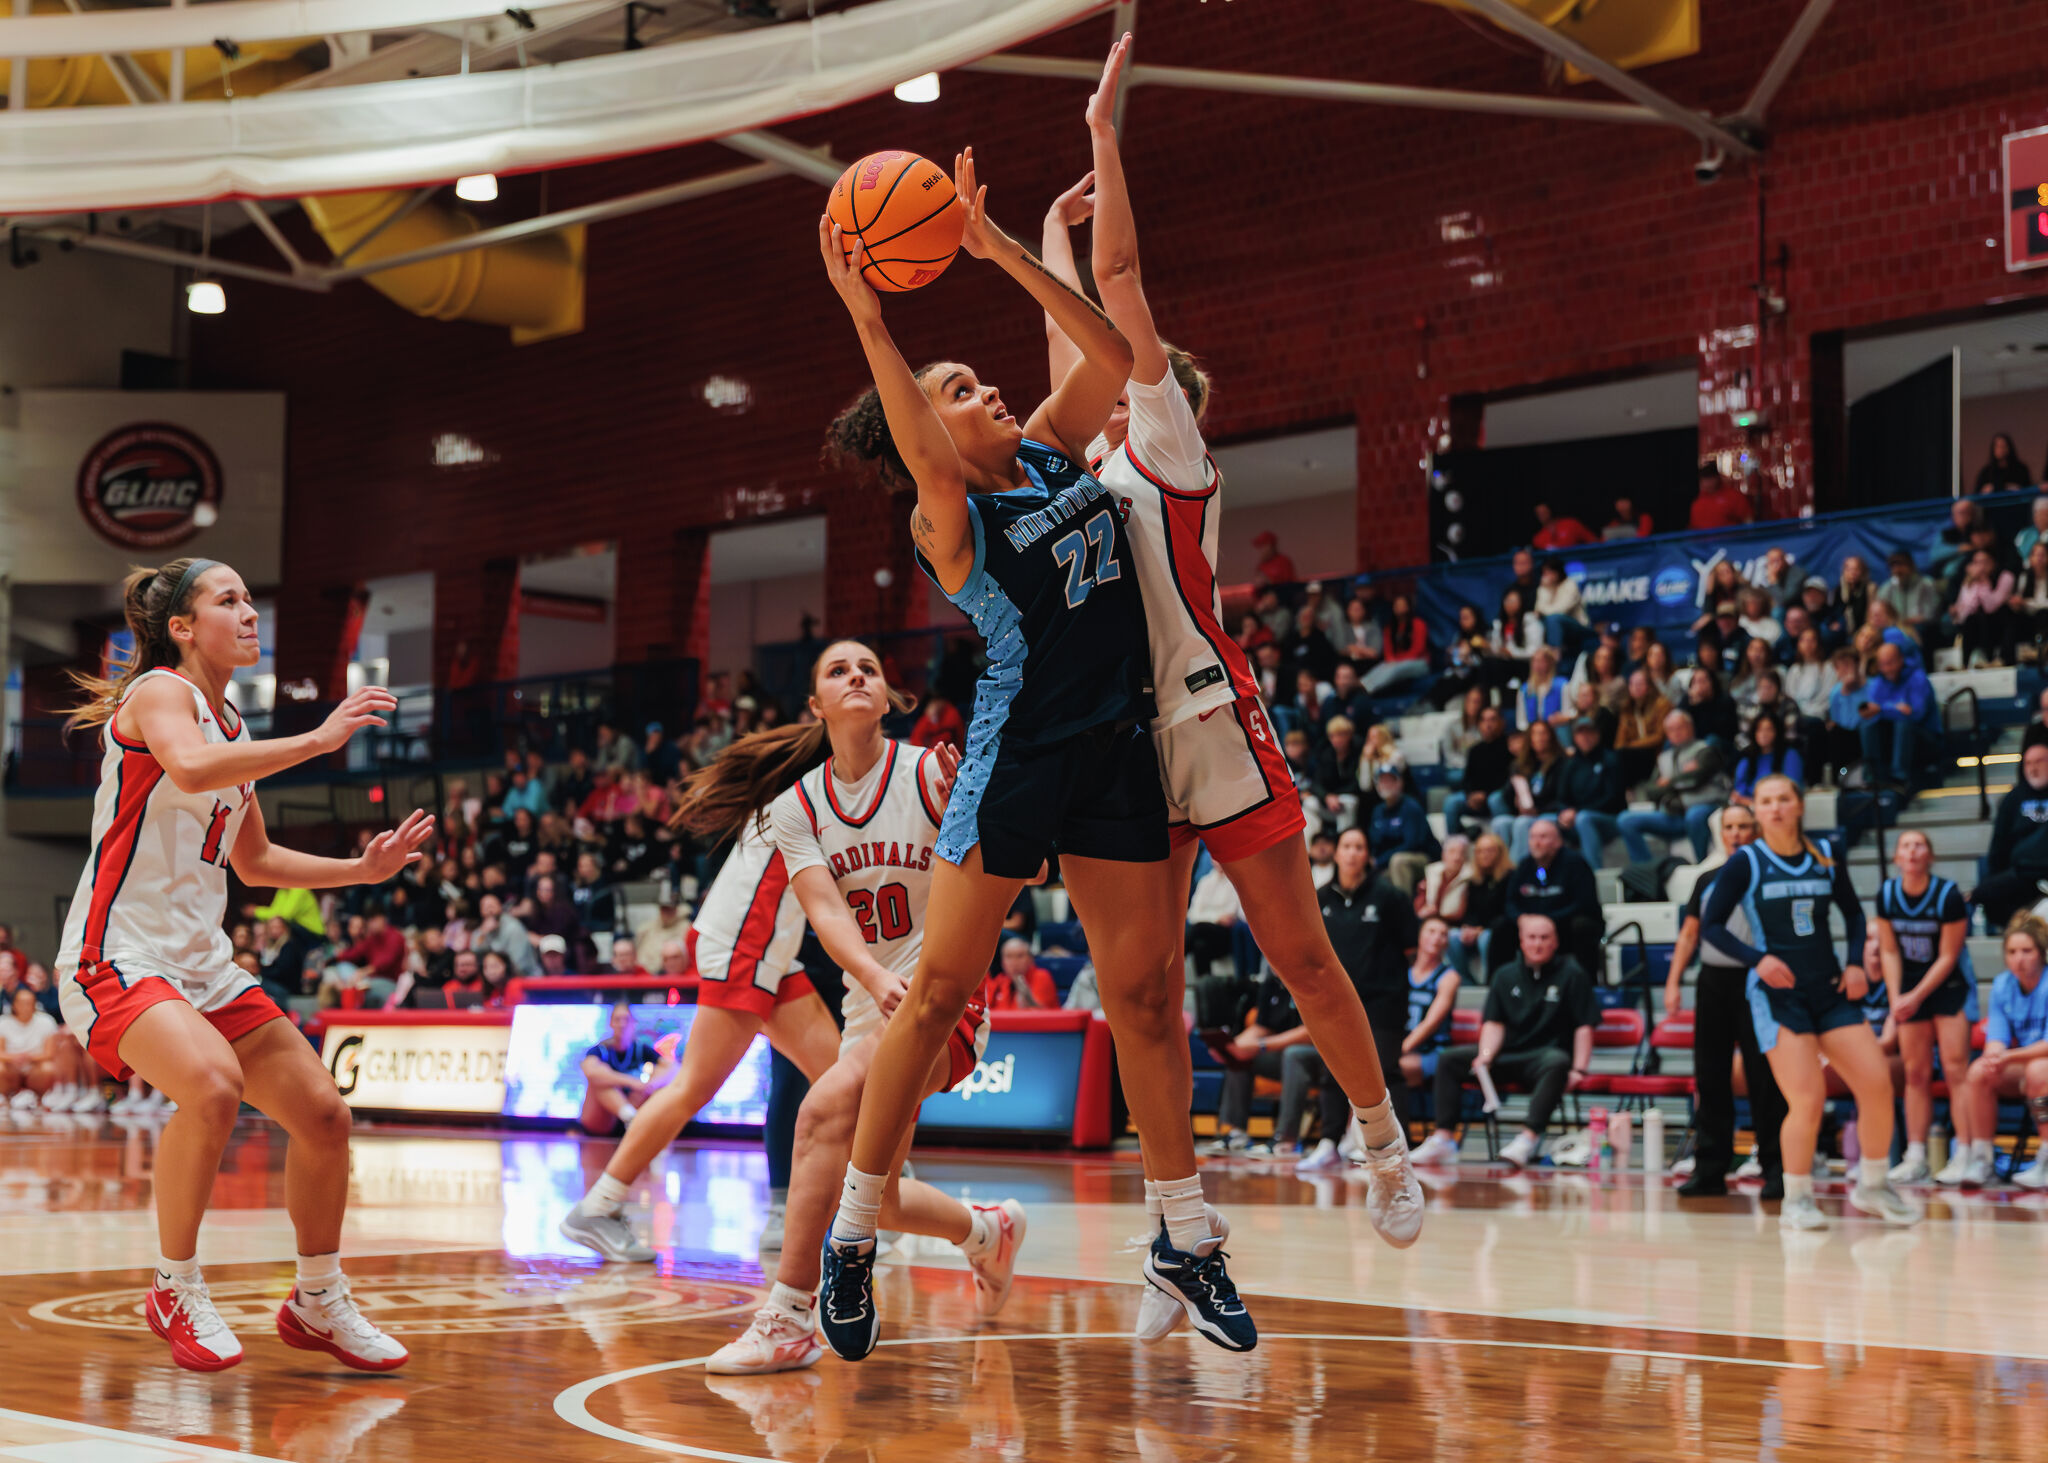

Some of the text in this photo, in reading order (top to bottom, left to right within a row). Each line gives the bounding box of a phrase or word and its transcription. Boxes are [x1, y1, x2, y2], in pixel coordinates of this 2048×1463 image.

[1003, 472, 1108, 553] NORTHWOO
[1051, 509, 1121, 609] 22
[1582, 576, 1650, 605] MAKE
[200, 798, 228, 868] 1
[847, 882, 912, 944] 20
[1792, 898, 1815, 937] 5
[951, 1053, 1016, 1101] psi
